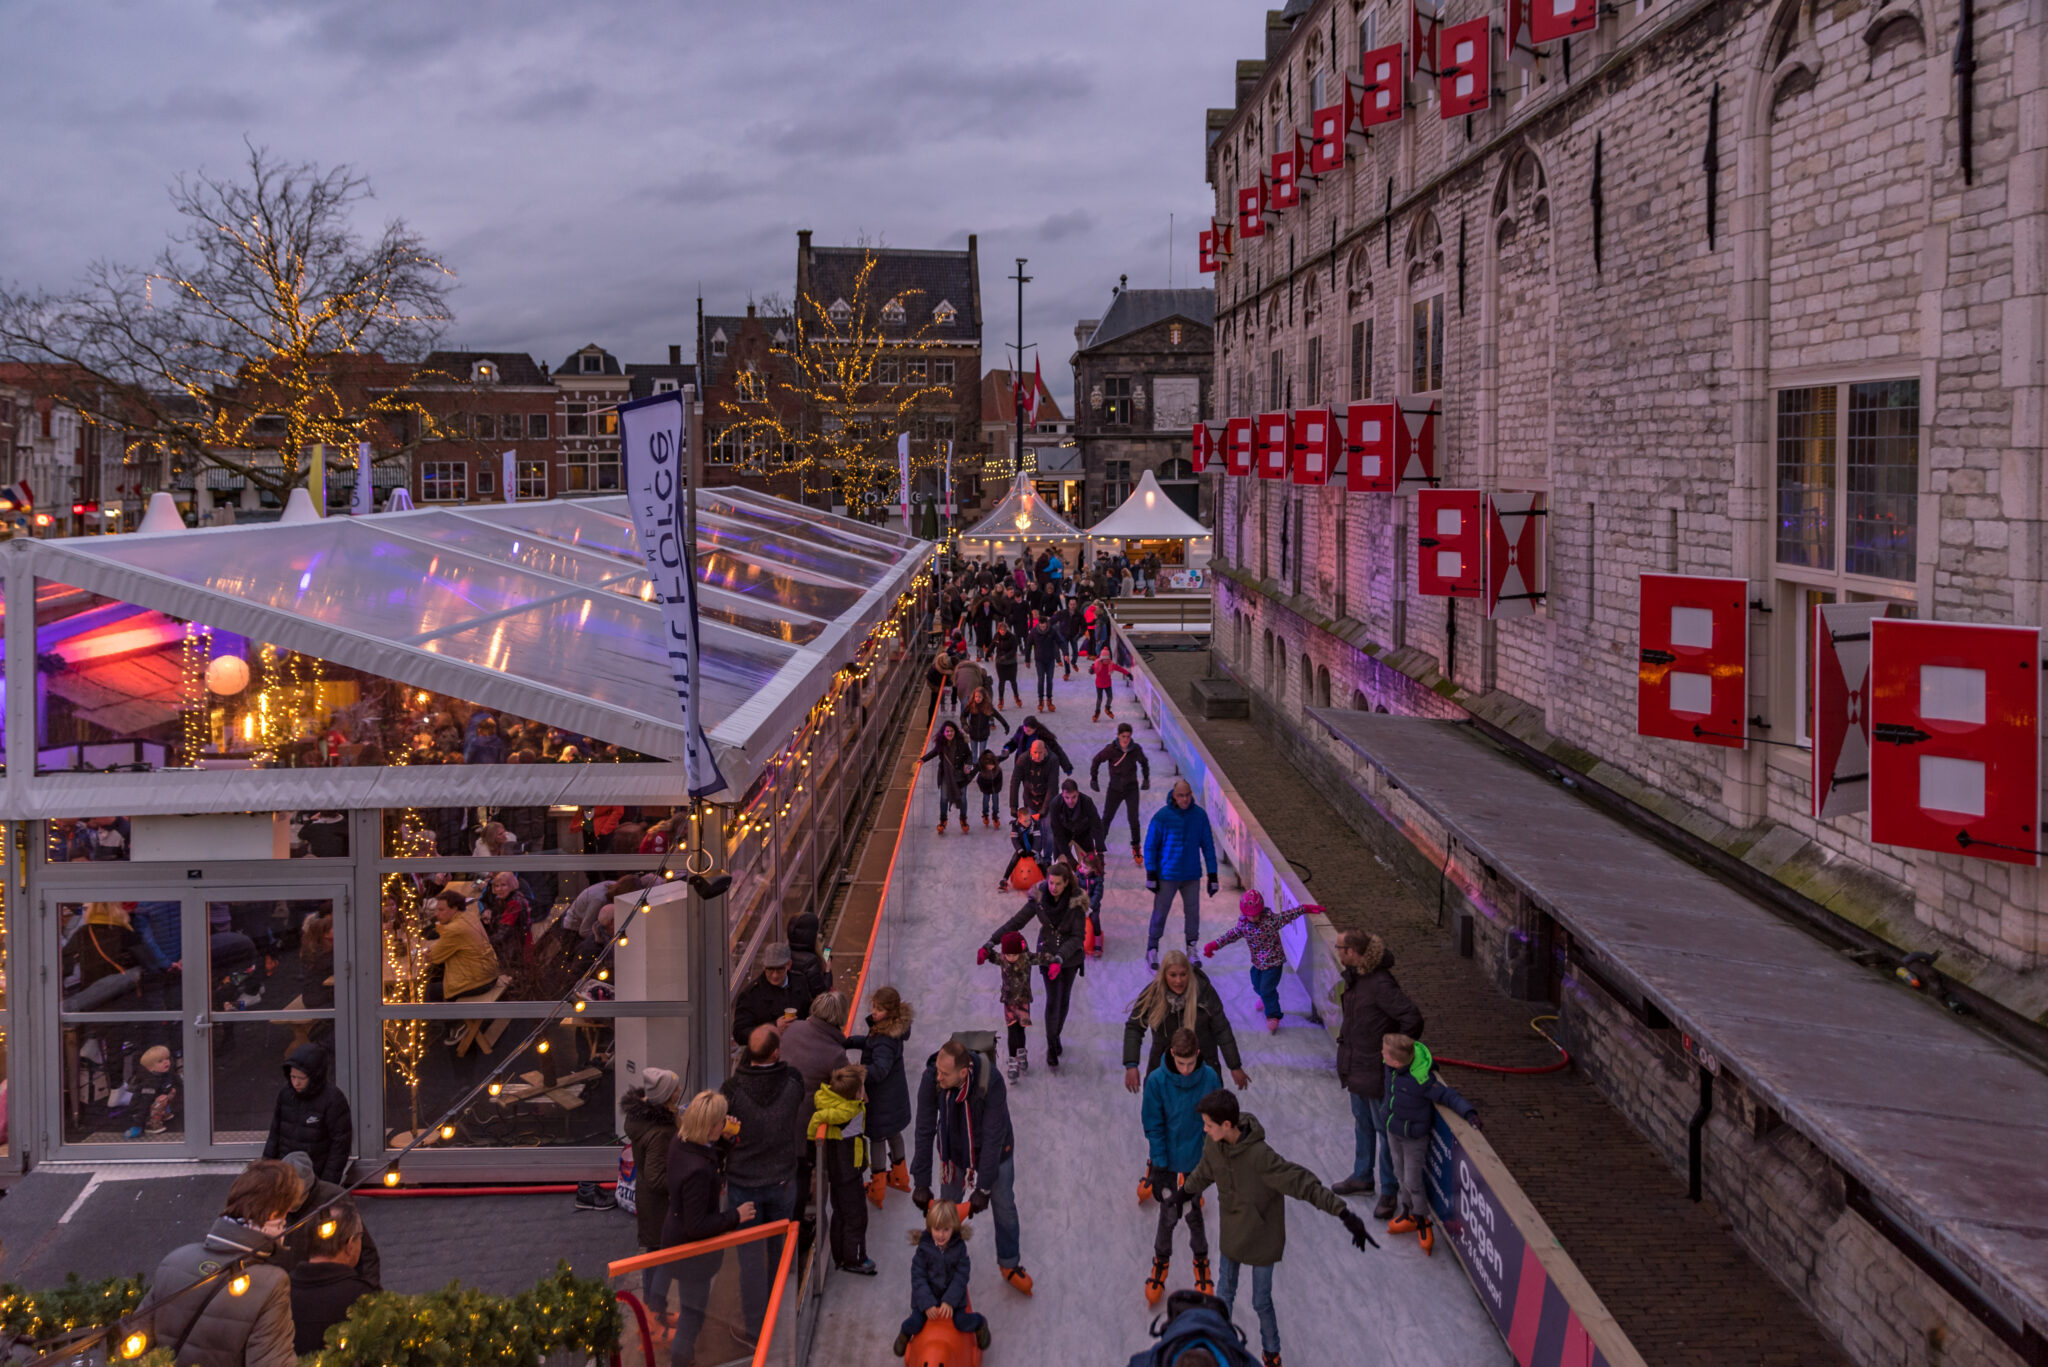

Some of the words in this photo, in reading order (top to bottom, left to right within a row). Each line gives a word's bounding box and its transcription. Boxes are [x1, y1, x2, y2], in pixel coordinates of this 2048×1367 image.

[1460, 1160, 1495, 1233] Open
[1461, 1188, 1503, 1279] Dagen
[1472, 1249, 1502, 1309] februari
